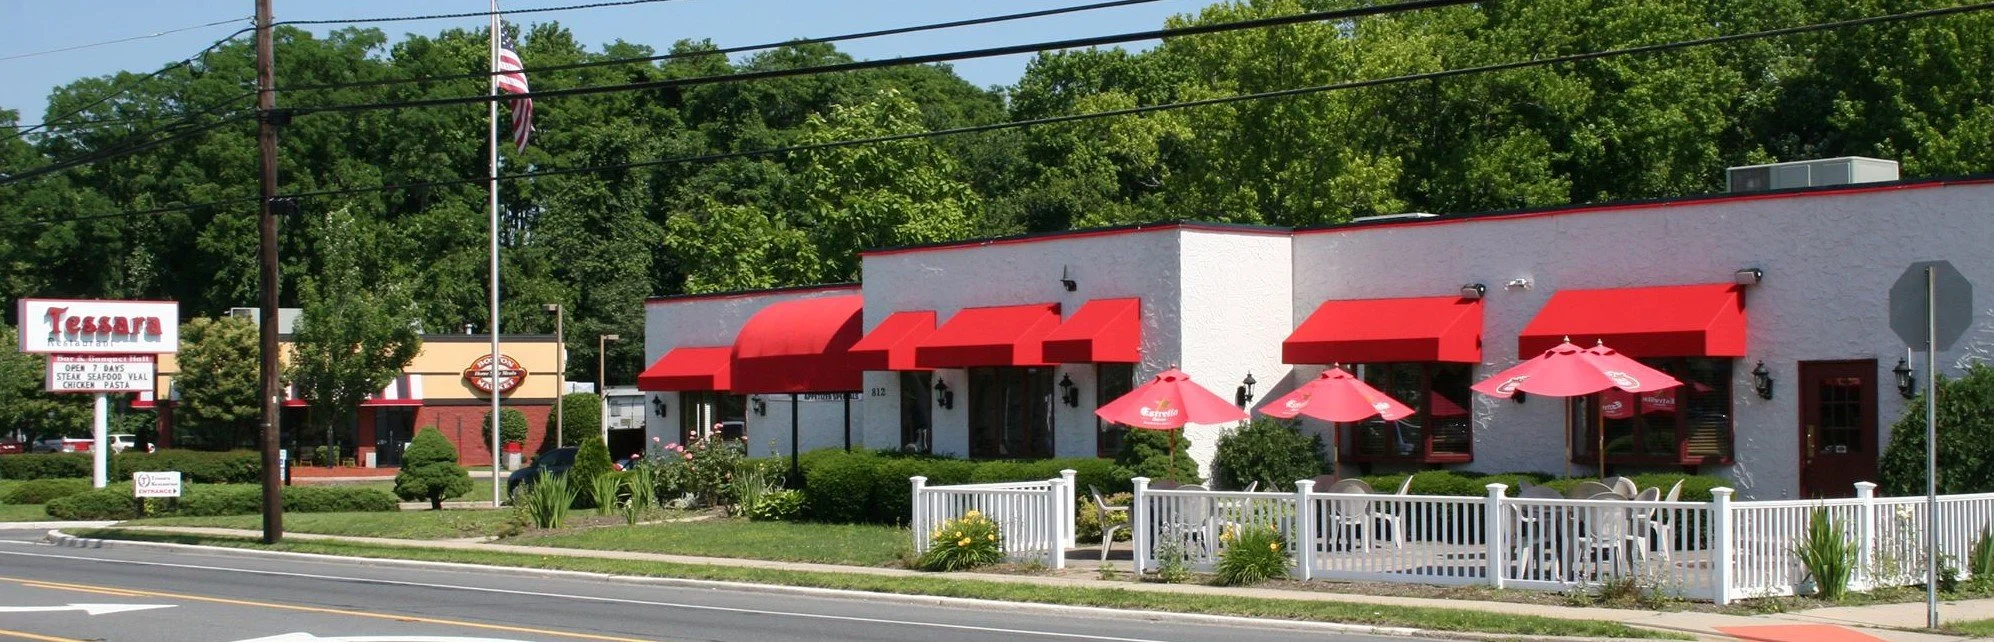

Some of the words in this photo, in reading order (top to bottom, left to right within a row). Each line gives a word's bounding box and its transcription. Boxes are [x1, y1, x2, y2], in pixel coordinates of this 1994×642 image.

[44, 306, 163, 339] Tessara
[477, 357, 514, 368] BOON
[65, 364, 85, 372] OPEN
[93, 364, 98, 372] 7
[104, 364, 125, 372] DAYS
[62, 381, 95, 389] CHICKEN
[104, 381, 130, 389] PASTA
[477, 379, 514, 390] MAKET
[871, 387, 886, 396] 812
